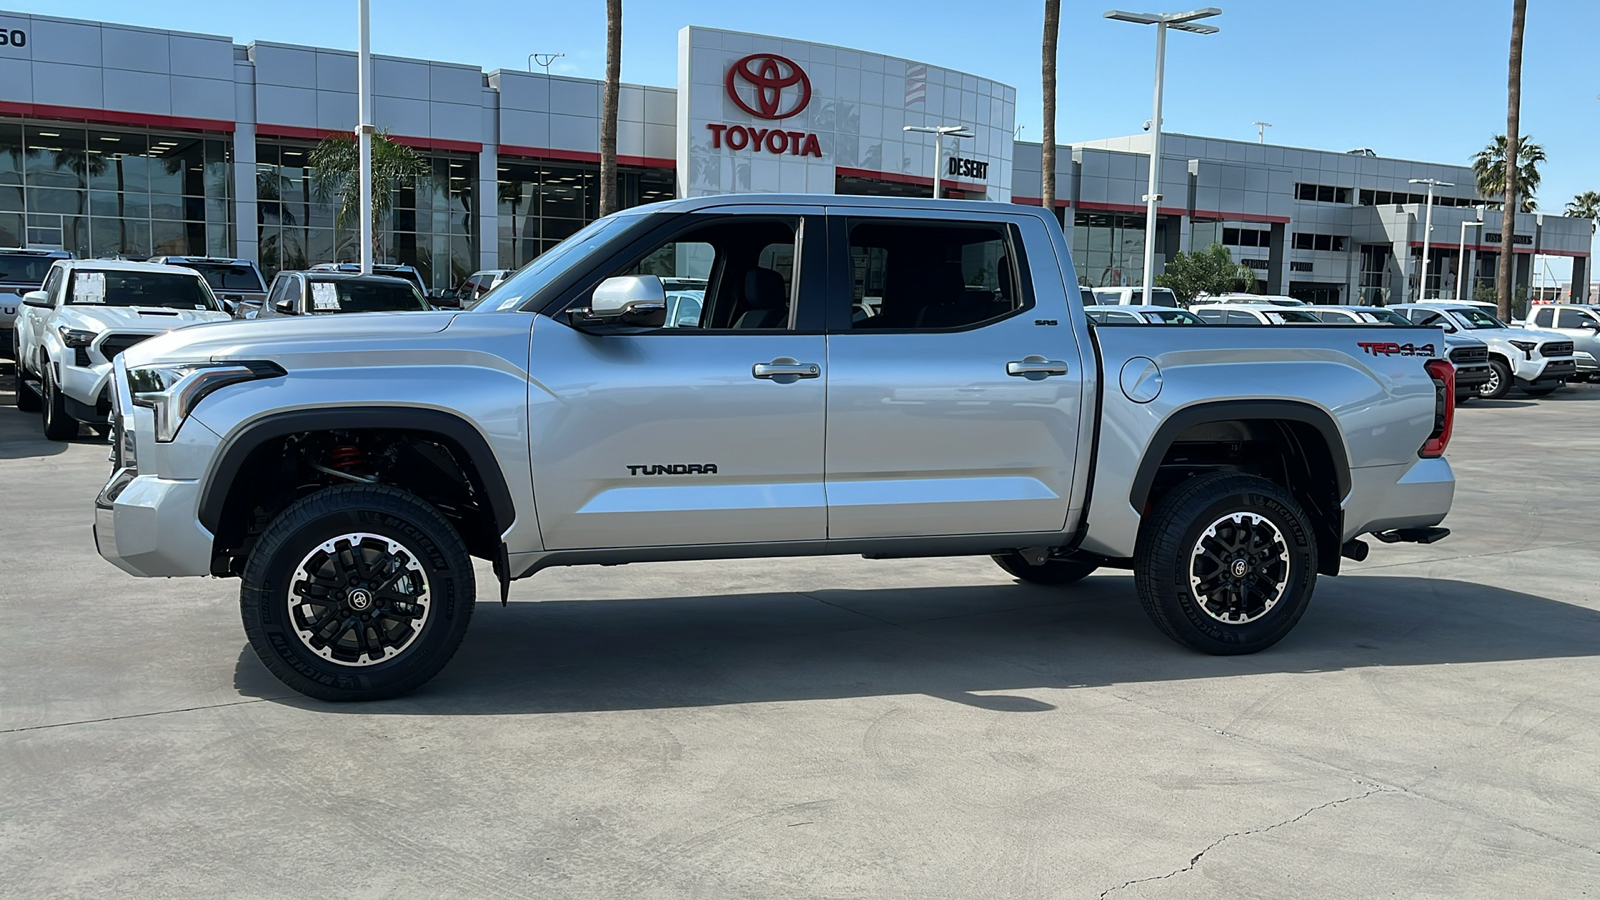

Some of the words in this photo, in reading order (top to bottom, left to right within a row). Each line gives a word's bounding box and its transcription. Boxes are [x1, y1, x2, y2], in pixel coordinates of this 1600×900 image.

[706, 123, 823, 158] TOYOTA
[948, 156, 989, 180] DESERT
[1356, 341, 1400, 357] TRD
[626, 463, 718, 476] TUNDRA
[1266, 499, 1308, 546] MICHELIN
[384, 516, 448, 570] MICHELIN
[271, 634, 337, 685] MICHELIN
